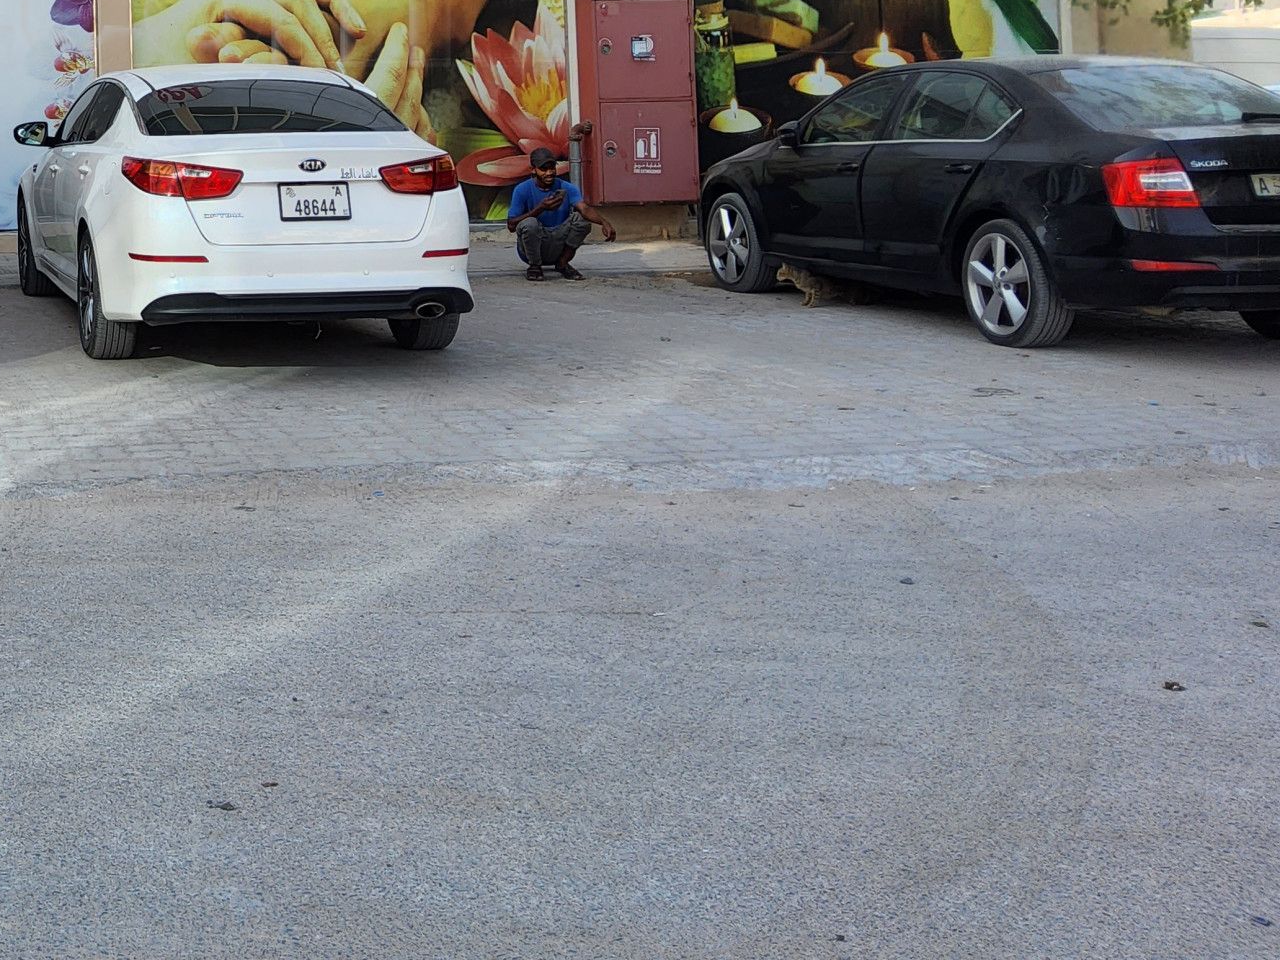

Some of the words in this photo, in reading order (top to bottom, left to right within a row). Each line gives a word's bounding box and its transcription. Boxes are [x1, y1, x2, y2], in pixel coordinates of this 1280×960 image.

[303, 161, 322, 170] KIA
[334, 186, 342, 197] A
[1258, 177, 1270, 194] A
[294, 198, 337, 216] 48644
